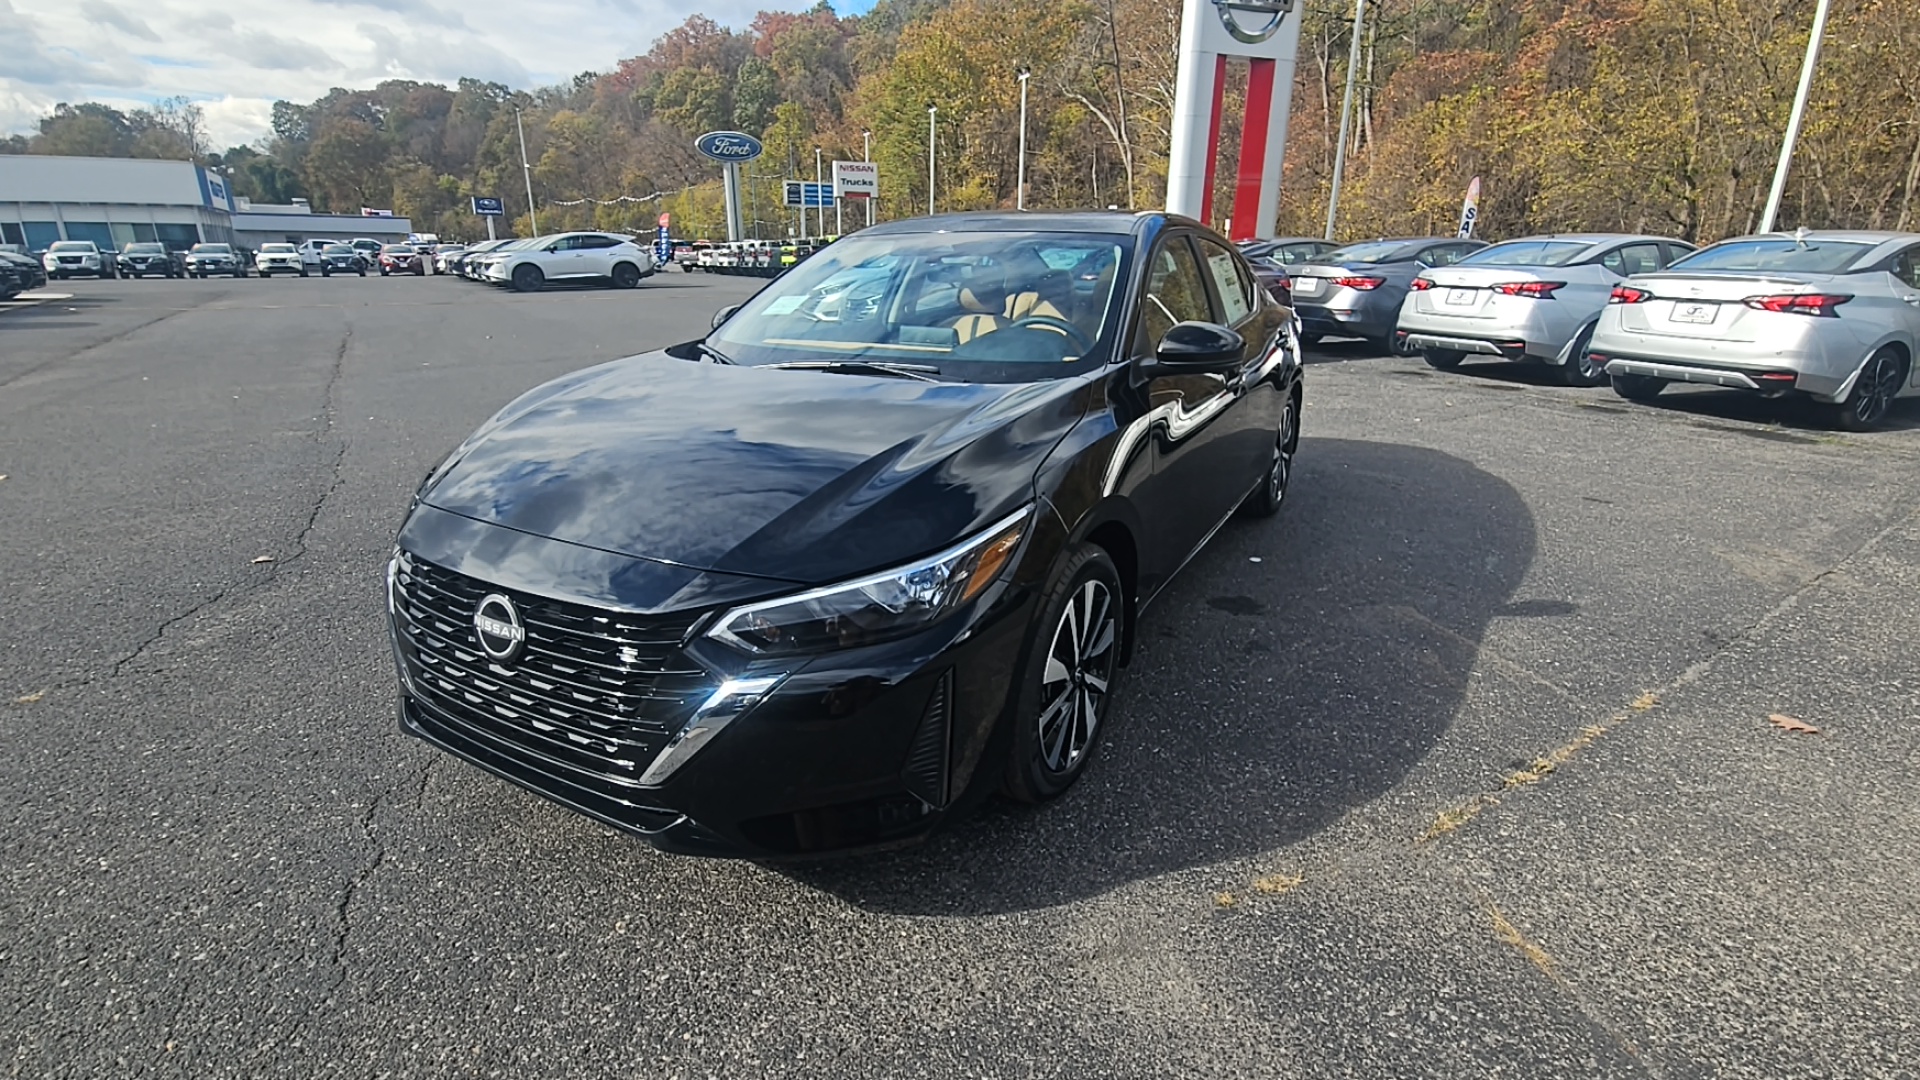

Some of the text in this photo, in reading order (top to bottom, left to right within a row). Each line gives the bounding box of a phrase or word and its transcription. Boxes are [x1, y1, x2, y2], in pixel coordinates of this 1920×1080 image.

[712, 137, 750, 155] Ford
[840, 178, 873, 186] Trucks
[475, 614, 521, 640] NISSAN
